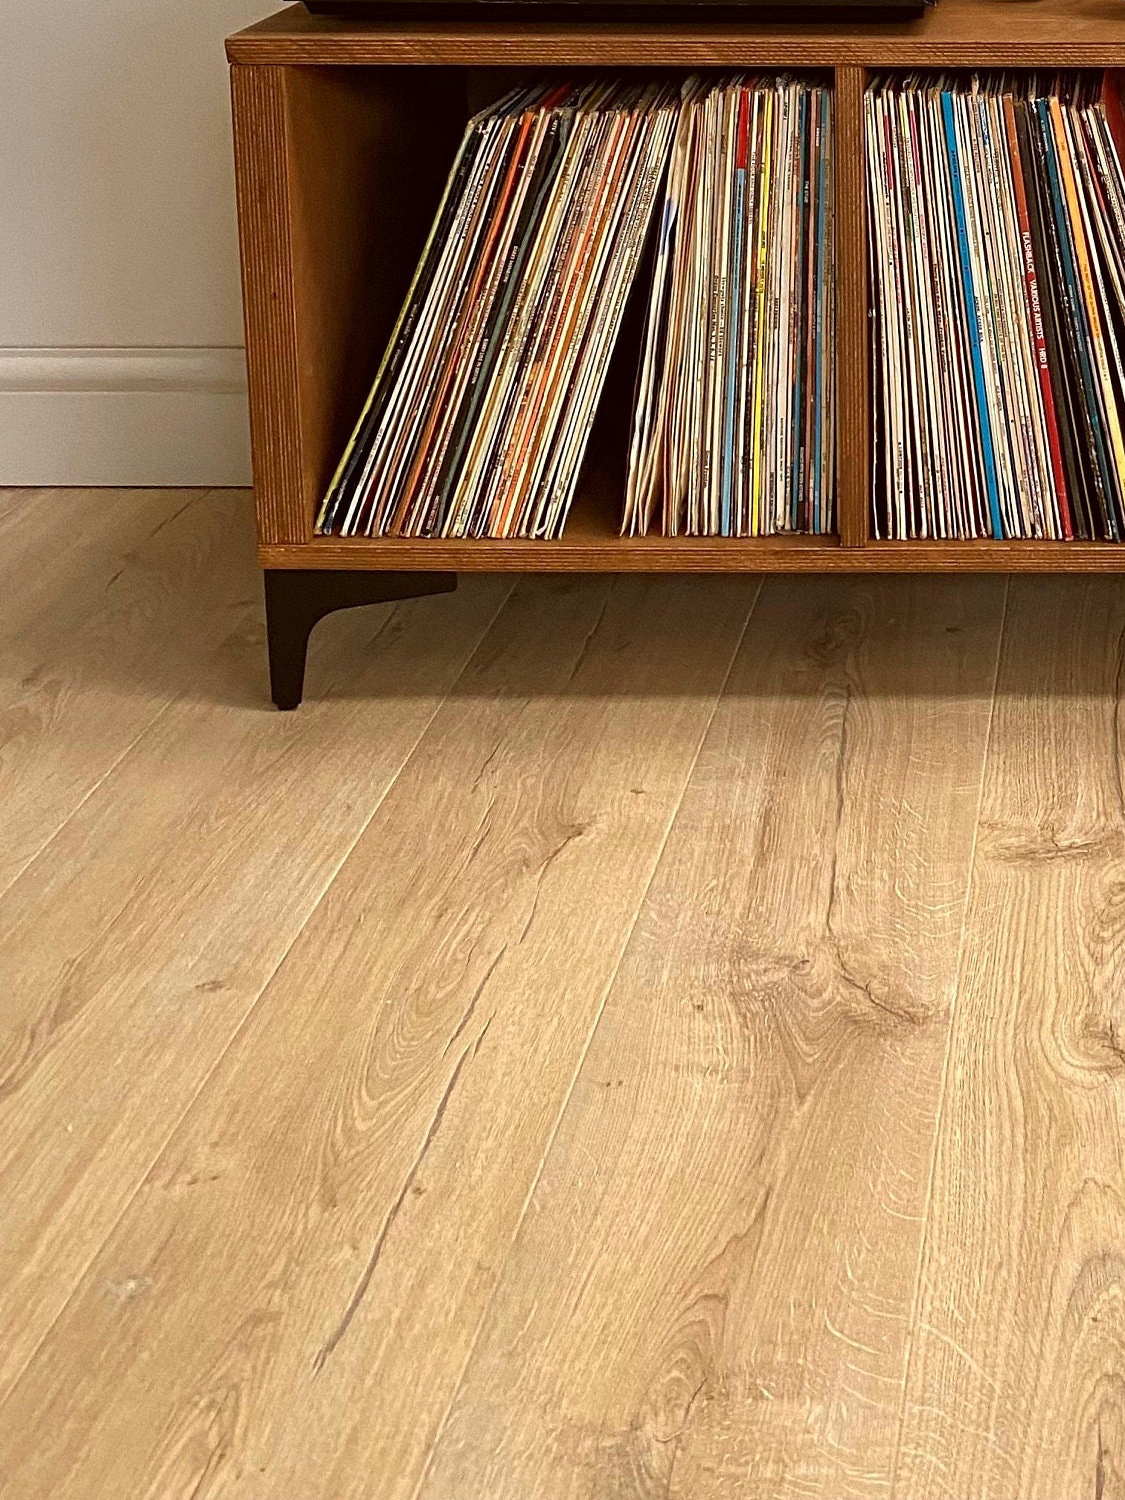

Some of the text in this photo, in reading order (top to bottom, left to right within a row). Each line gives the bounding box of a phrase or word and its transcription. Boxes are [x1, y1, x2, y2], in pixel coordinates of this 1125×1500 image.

[1021, 231, 1034, 273] FLASHBACK
[1028, 279, 1040, 311] VARIOUS
[1033, 312, 1044, 340] ARTISTS
[1038, 347, 1047, 363] HRD
